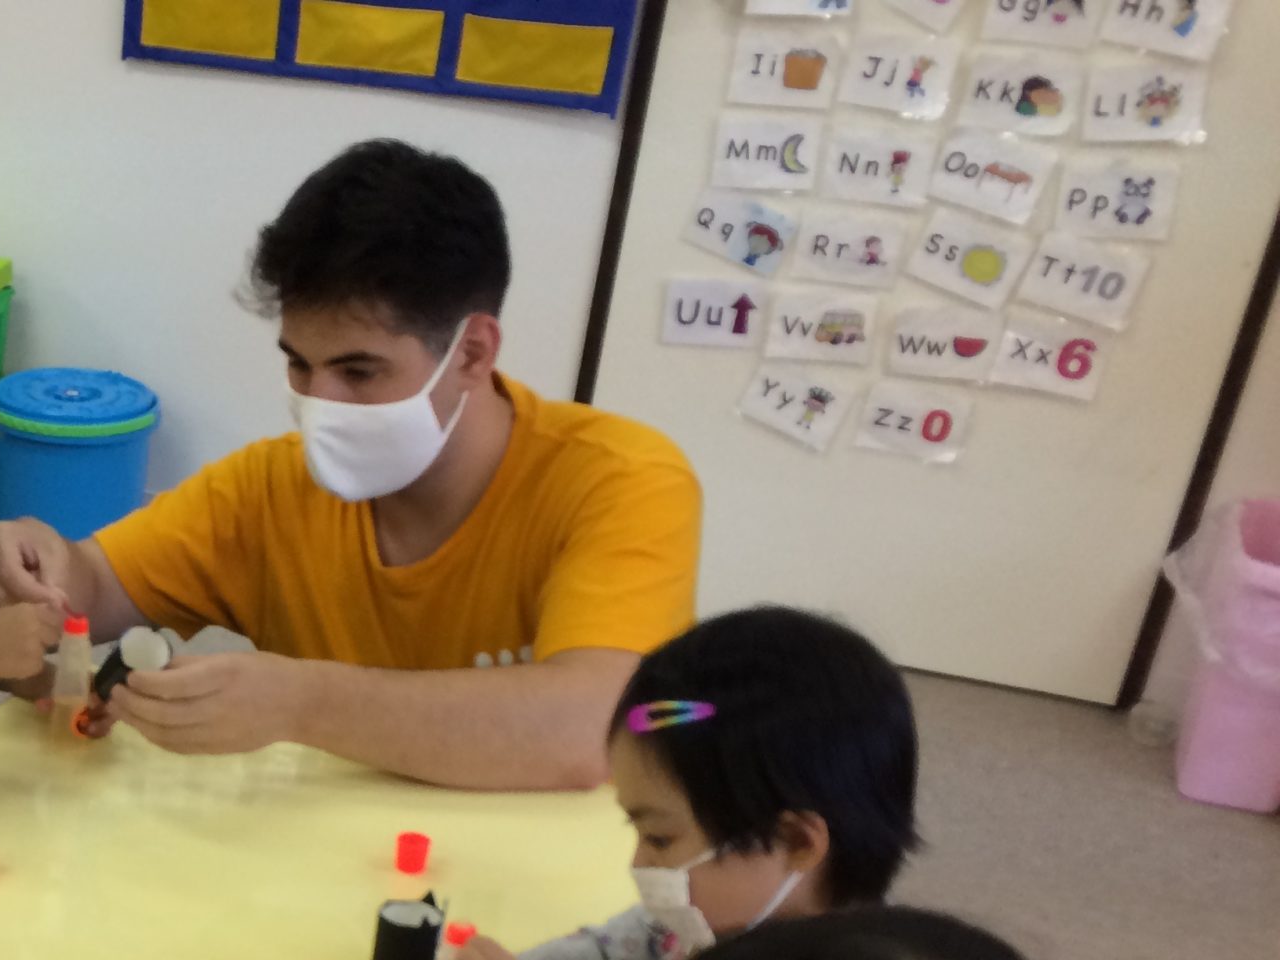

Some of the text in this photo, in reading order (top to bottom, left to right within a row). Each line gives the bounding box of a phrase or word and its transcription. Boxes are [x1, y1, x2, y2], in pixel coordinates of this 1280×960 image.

[862, 55, 900, 87] Jj
[974, 77, 1016, 103] Kk
[725, 138, 777, 161] Mm
[837, 151, 880, 177] Nn
[676, 297, 724, 327] Uu
[897, 333, 948, 357] Ww
[1055, 337, 1098, 381] 6
